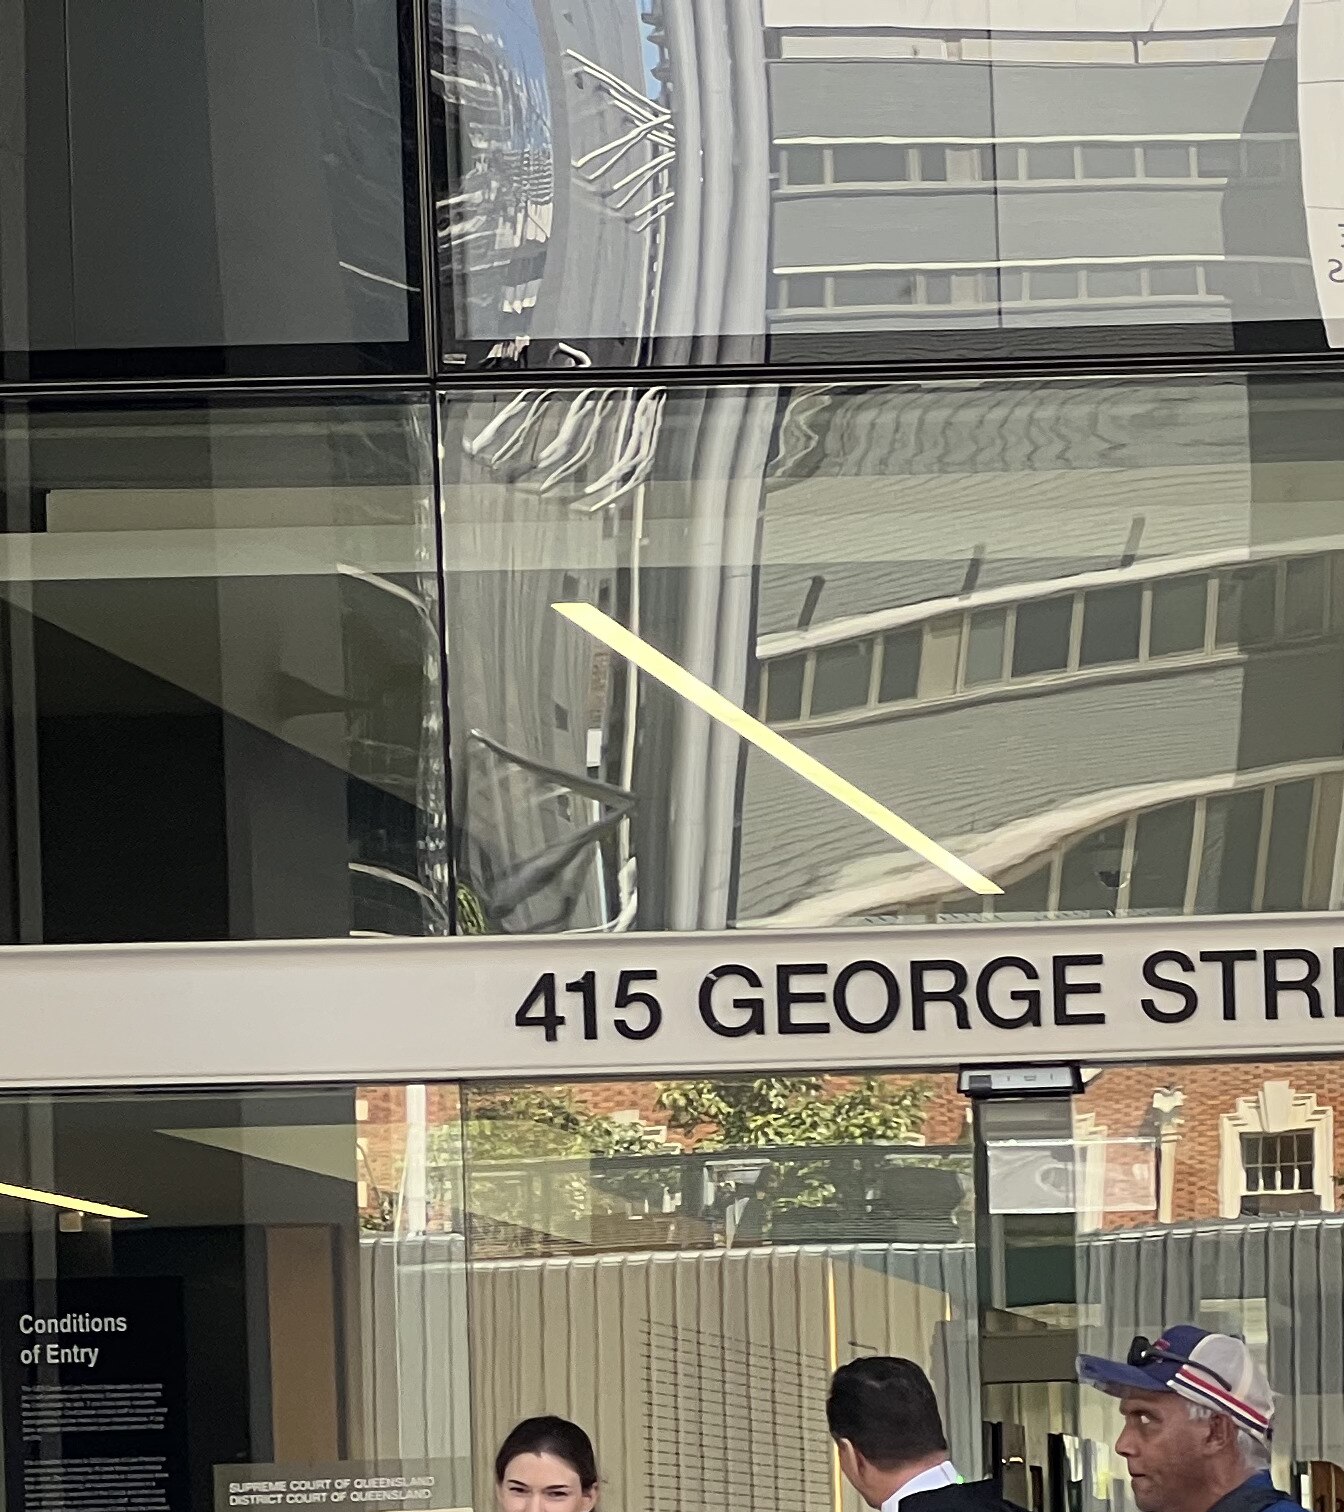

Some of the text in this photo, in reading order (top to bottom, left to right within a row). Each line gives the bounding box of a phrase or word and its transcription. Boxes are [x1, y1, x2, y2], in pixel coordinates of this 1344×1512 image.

[514, 968, 662, 1042] 415
[697, 953, 1106, 1039] GEORGE
[19, 1312, 128, 1335] Conditions
[20, 1344, 99, 1368] of Entry
[229, 1476, 435, 1493] SUPREME COURT OF QUEENSLAND
[229, 1489, 432, 1506] DISTRICT COURT OF QUEENSLAND
